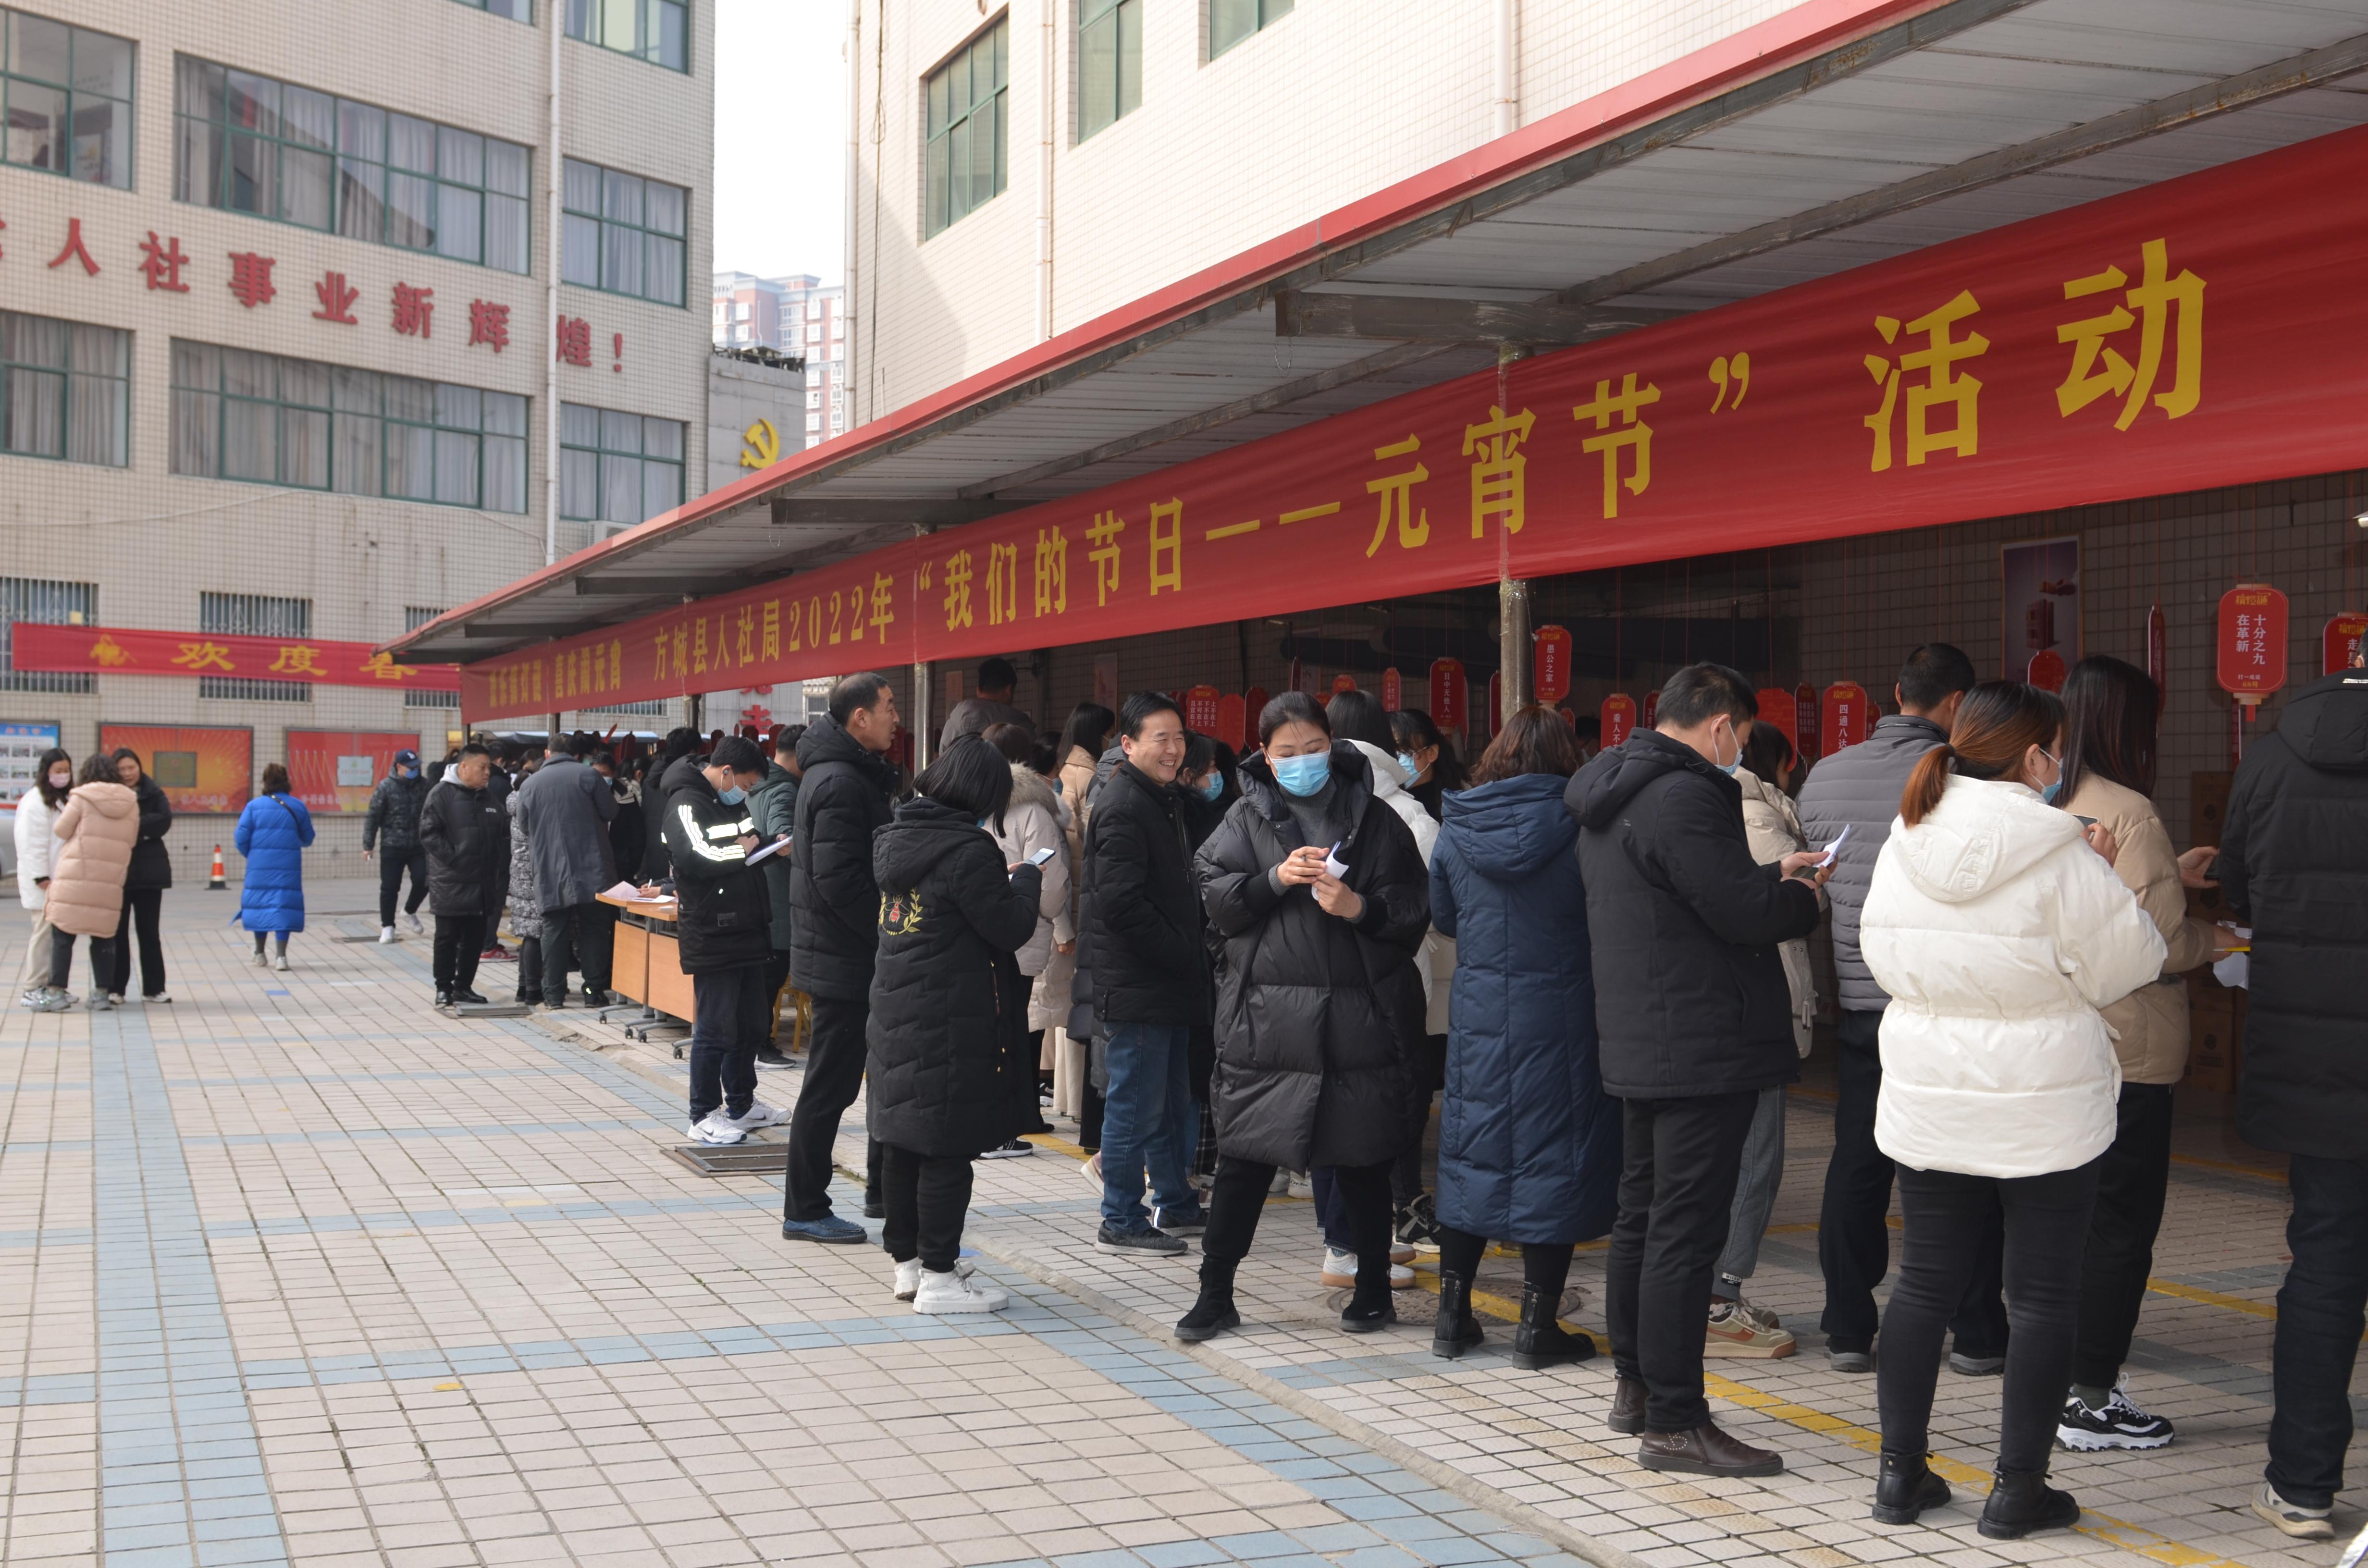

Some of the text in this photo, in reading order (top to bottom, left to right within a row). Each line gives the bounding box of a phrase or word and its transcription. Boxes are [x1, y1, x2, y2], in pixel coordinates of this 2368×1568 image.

[0, 211, 623, 373] 人社事业新辉煌！
[2236, 614, 2250, 652] 在革新
[2253, 614, 2267, 665] 十分之九
[2347, 638, 2359, 668] 走是
[1545, 644, 1555, 683] 愚公之家
[1838, 704, 1849, 749] 四通八达
